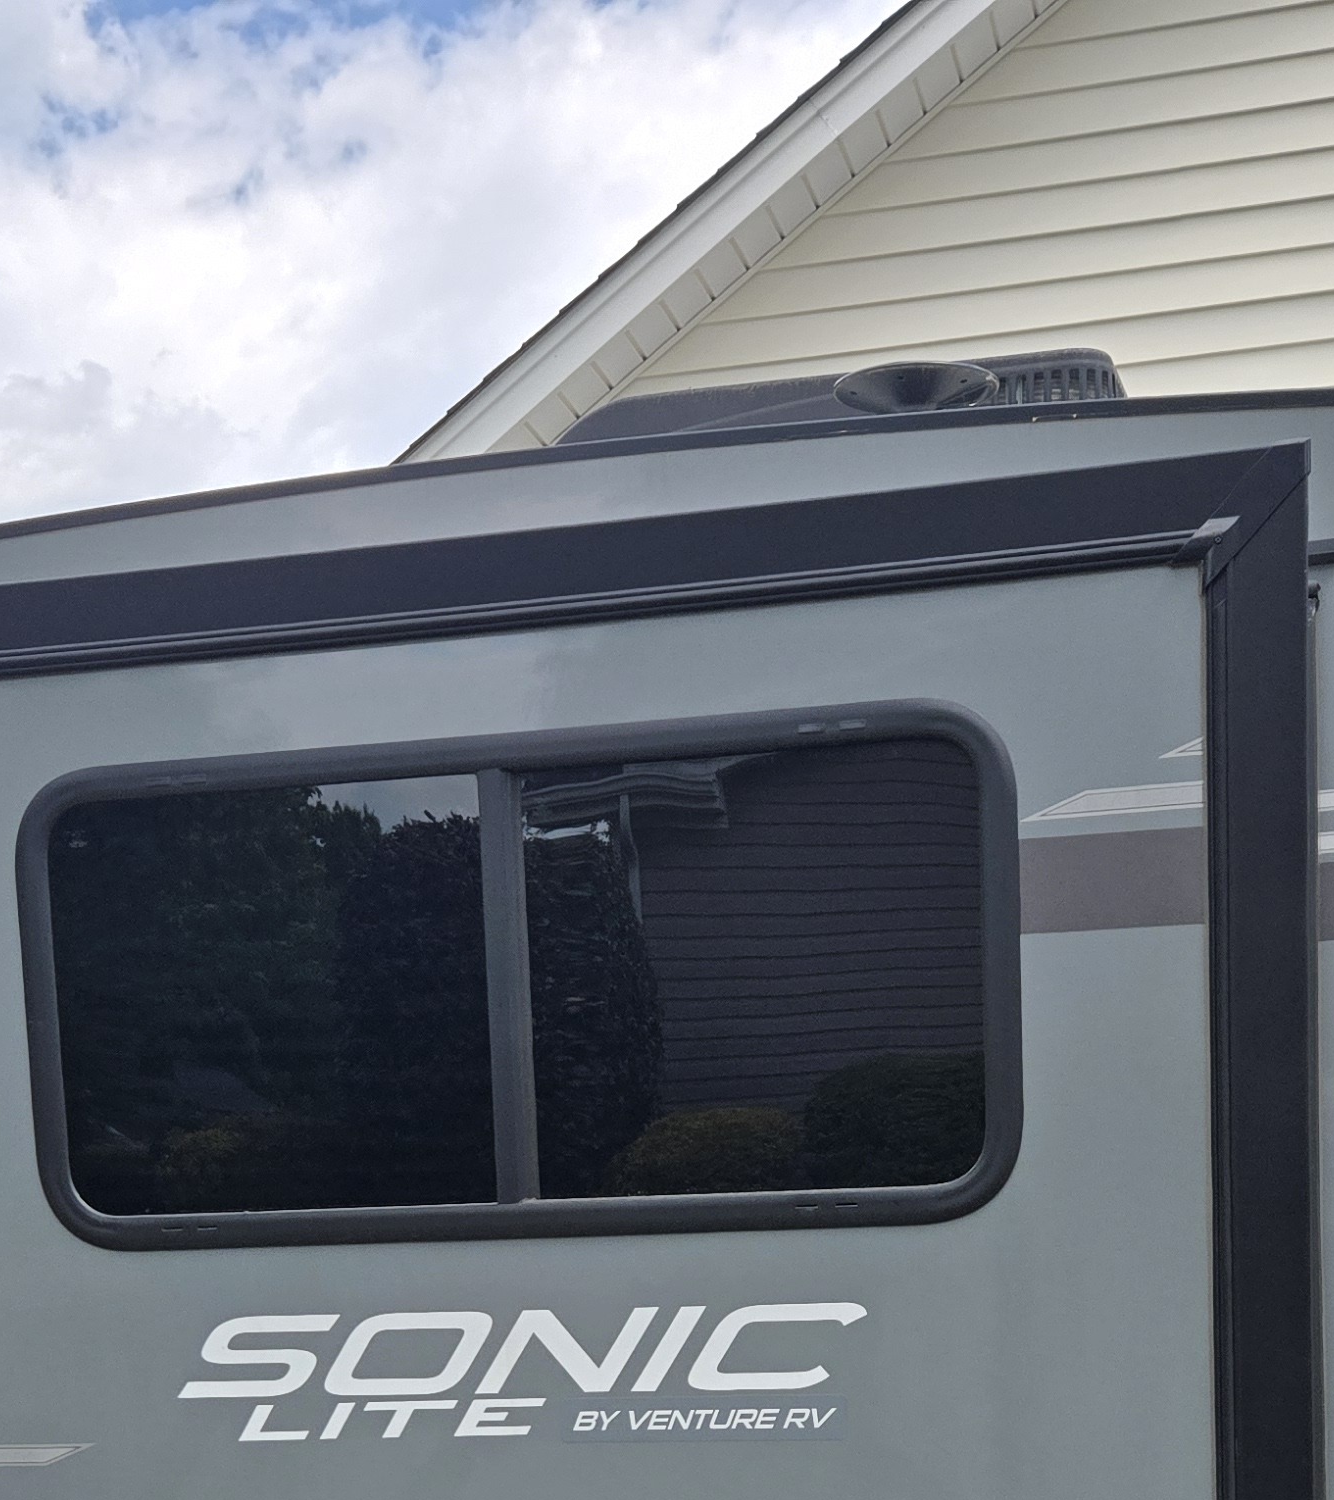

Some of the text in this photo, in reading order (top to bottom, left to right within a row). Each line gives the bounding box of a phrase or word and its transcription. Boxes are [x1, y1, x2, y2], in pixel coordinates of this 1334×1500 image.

[177, 1302, 868, 1399] SONIC
[238, 1398, 547, 1441] LITE
[573, 1407, 837, 1431] BY VENTURE RV
